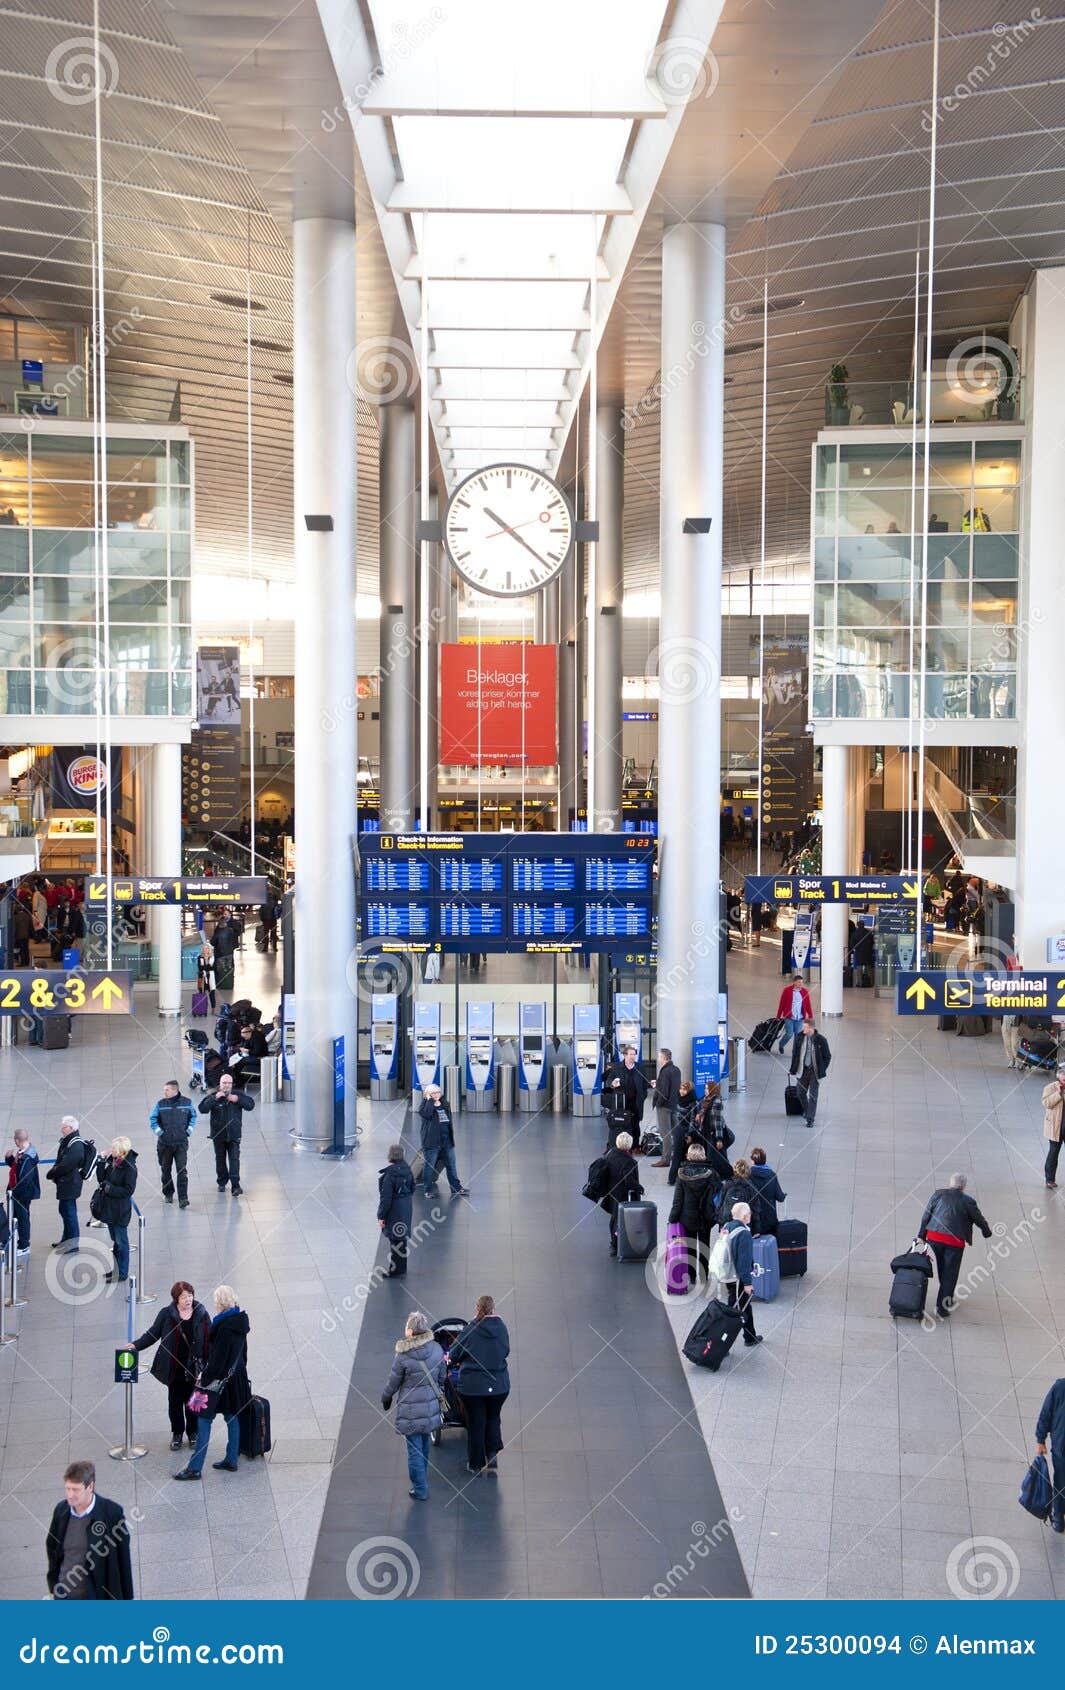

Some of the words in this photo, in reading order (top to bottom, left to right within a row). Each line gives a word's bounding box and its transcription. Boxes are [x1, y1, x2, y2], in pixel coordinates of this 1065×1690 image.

[139, 881, 163, 891] Spor
[799, 880, 821, 889] Spor
[832, 881, 840, 899] 1
[139, 891, 166, 900] Track
[172, 882, 181, 900] 1
[799, 890, 825, 899] Track
[434, 943, 442, 952] 3
[984, 977, 1047, 991] Terminal
[0, 978, 21, 1008] 2
[30, 978, 56, 1008] &
[65, 978, 86, 1008] 3
[984, 994, 1047, 1008] Terminal
